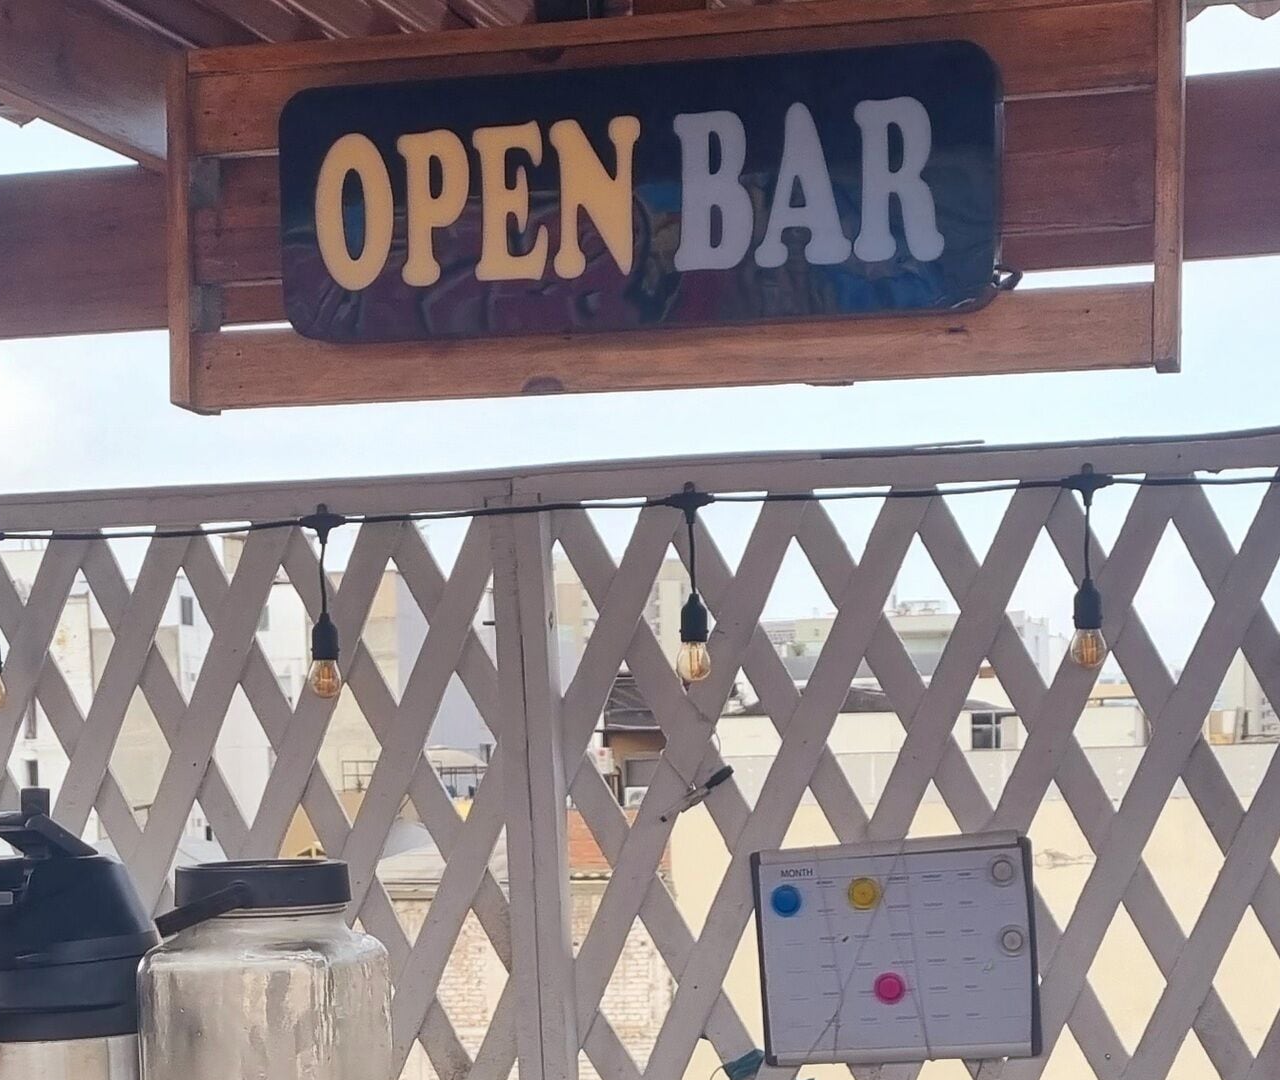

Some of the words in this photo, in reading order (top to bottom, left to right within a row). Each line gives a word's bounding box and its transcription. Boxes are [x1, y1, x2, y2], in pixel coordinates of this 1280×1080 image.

[315, 114, 641, 291] OPEN
[673, 96, 946, 270] BAR
[780, 867, 813, 878] MONTH
